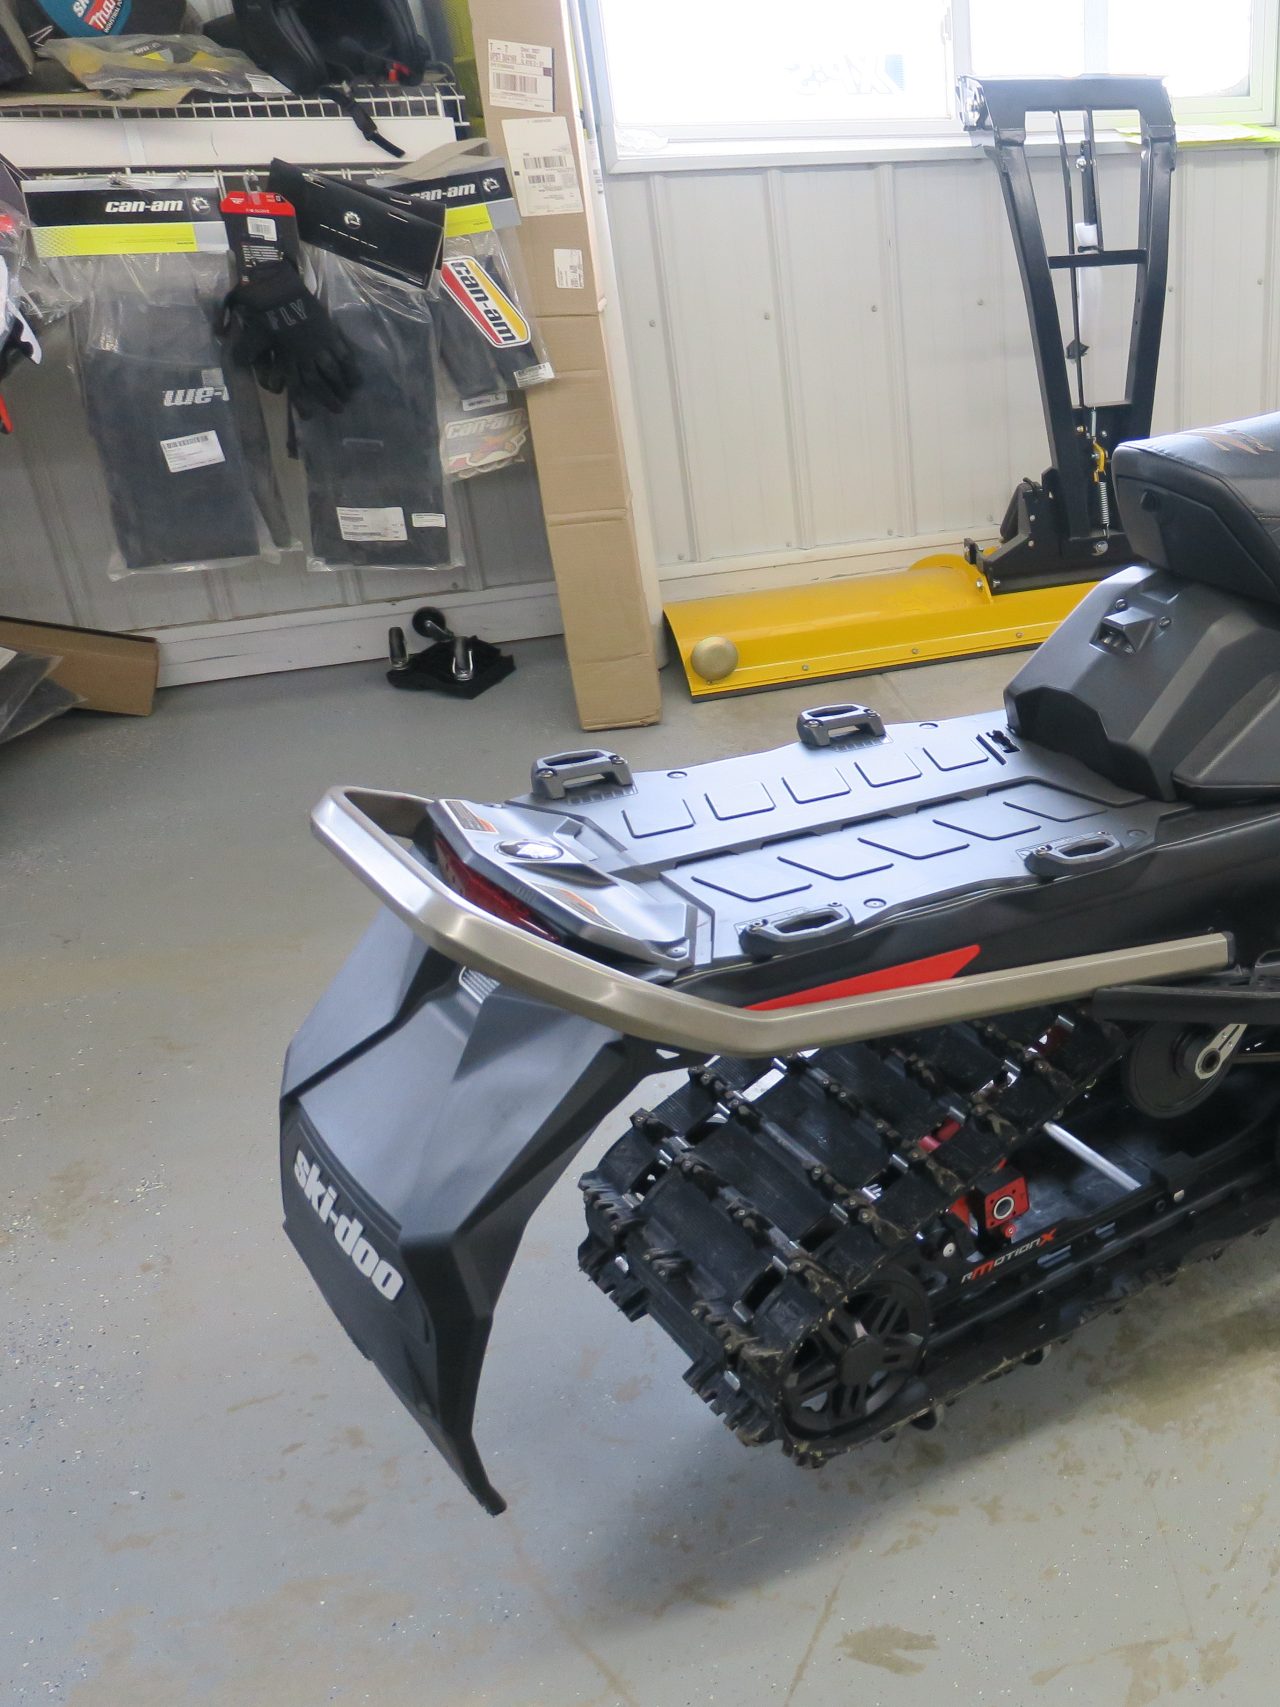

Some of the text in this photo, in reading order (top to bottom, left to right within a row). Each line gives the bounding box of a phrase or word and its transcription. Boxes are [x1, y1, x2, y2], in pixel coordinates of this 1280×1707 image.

[105, 200, 184, 213] can-am
[266, 299, 308, 330] FLY
[452, 261, 516, 341] can-am
[294, 1150, 404, 1301] ski-doo
